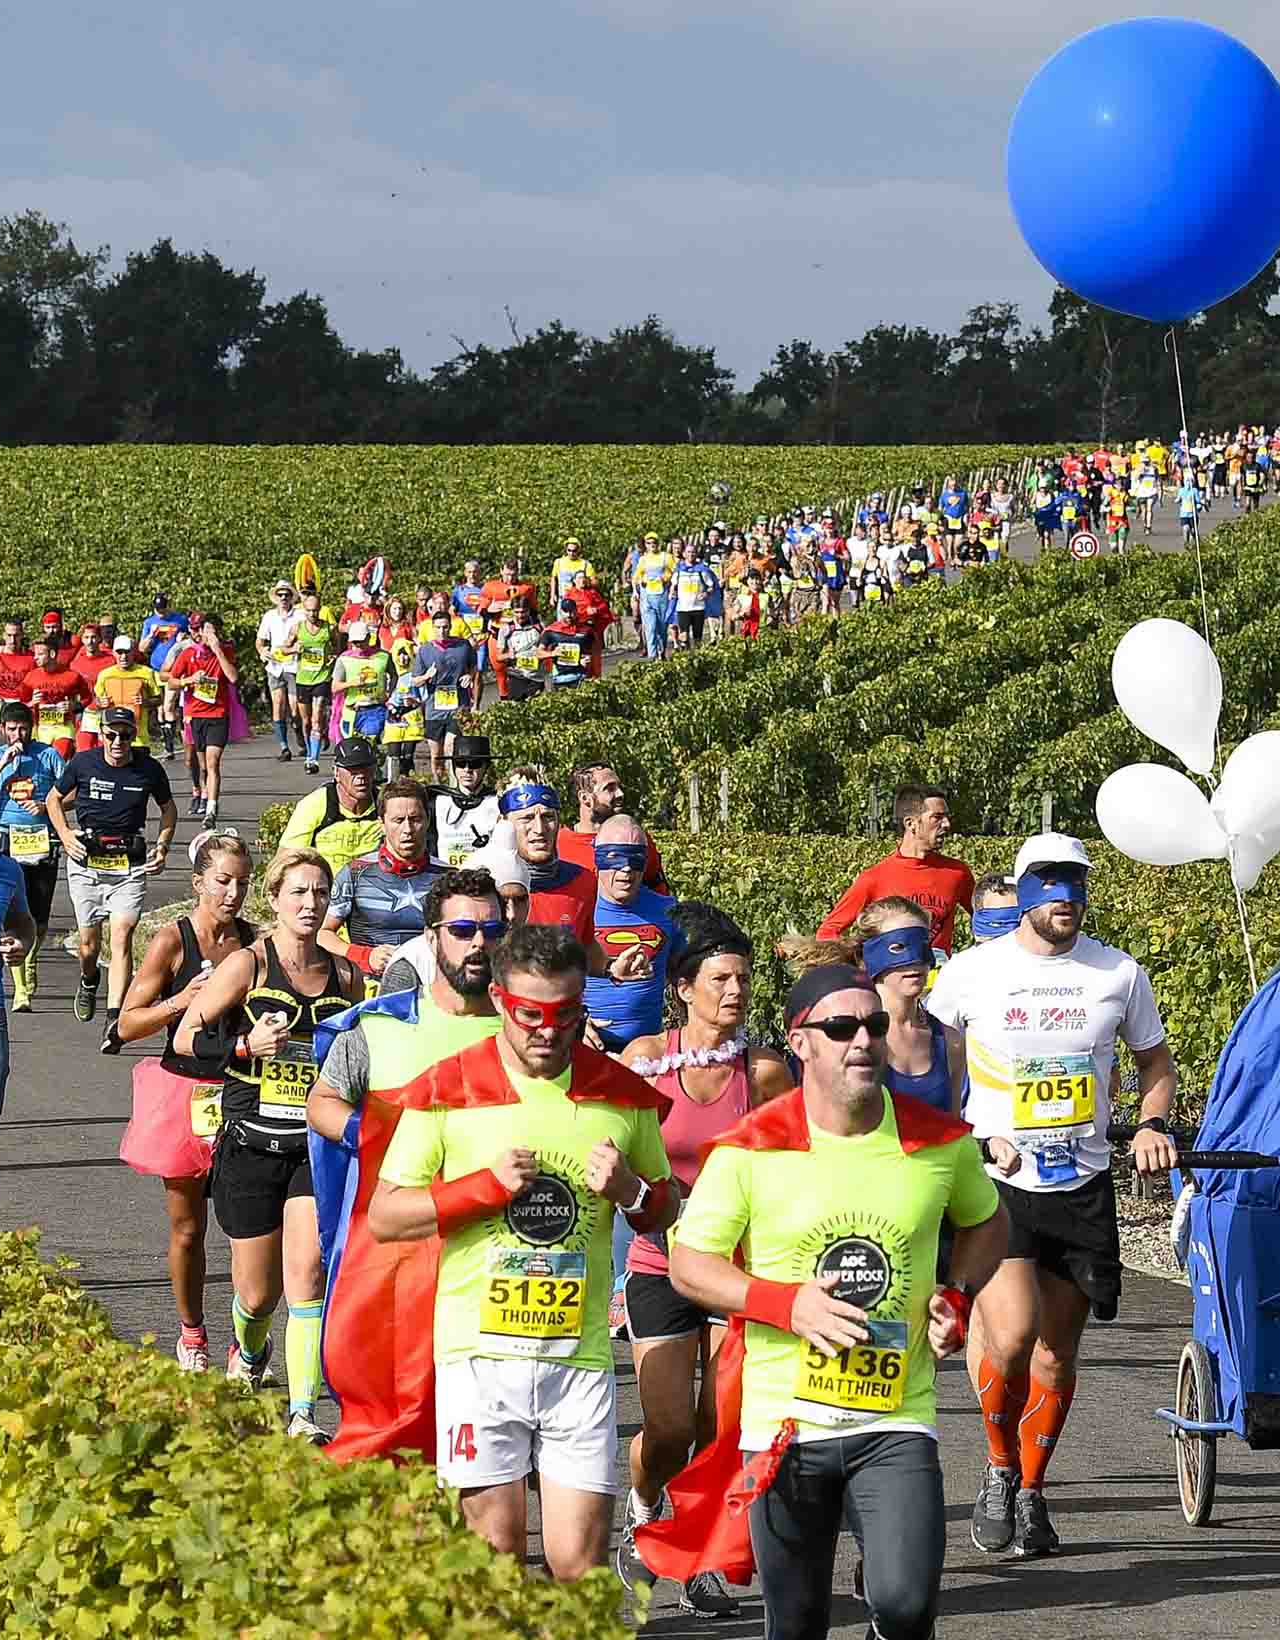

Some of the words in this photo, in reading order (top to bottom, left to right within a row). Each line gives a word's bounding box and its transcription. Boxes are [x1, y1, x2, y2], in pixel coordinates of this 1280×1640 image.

[1076, 540, 1094, 553] 30
[1032, 986, 1085, 997] BROOKS
[1017, 1077, 1088, 1103] 7051
[530, 1193, 554, 1203] AOC
[512, 1206, 543, 1217] SUPER
[544, 1206, 570, 1217] BOCK
[839, 1255, 867, 1268] AOC
[856, 1270, 884, 1283] BOCK
[488, 1278, 580, 1308] 5132
[500, 1308, 567, 1326] THOMAS
[806, 1341, 901, 1381] 5136
[808, 1374, 893, 1399] MATTHIEU
[447, 1423, 478, 1462] 14
